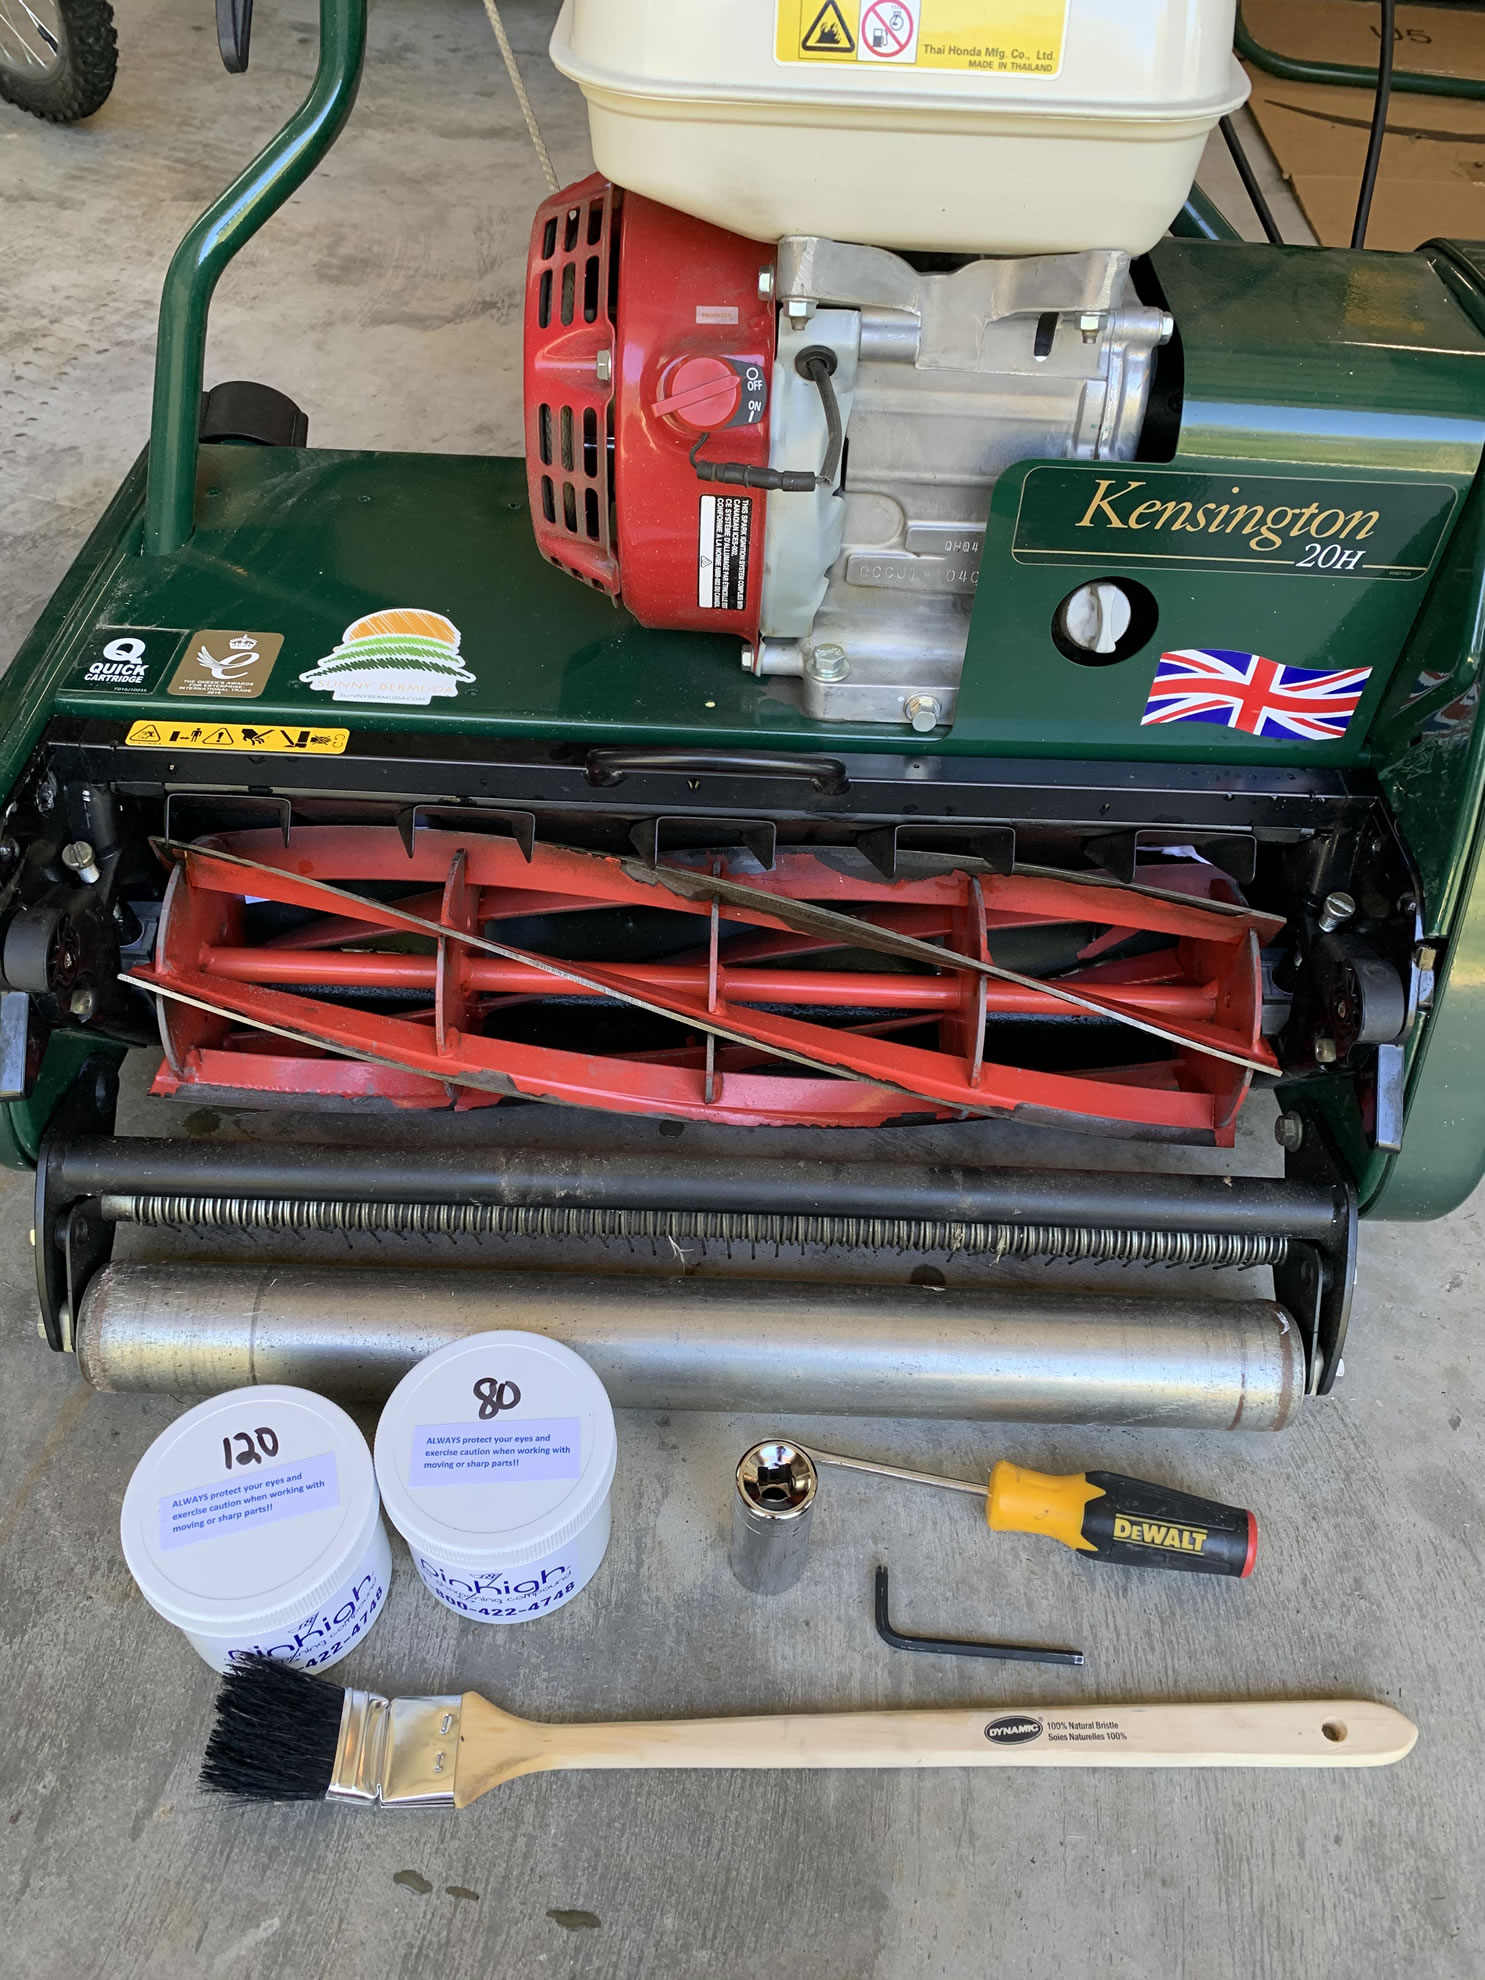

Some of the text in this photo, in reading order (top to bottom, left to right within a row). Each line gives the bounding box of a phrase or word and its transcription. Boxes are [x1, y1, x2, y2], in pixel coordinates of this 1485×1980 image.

[923, 44, 1055, 60] Thai Honda Mfg. Co., Ltd.
[968, 60, 1052, 72] MADE IN THAILAND
[747, 380, 762, 391] OFF
[748, 400, 761, 412] ON
[725, 498, 732, 507] CE
[741, 499, 749, 514] THIS
[716, 498, 724, 533] CONFORME
[732, 499, 741, 531] CANADIAN
[1075, 478, 1380, 552] Kensington
[740, 515, 748, 536] SPARK
[1295, 544, 1366, 571] 20H
[102, 637, 146, 664] Q
[88, 662, 149, 676] QUICK
[84, 673, 144, 684] CARTRIDGE
[317, 680, 454, 694] SUNNY BERMUDA
[473, 1377, 522, 1420] 80
[222, 1426, 279, 1470] 120
[426, 1434, 550, 1446] ALWAYS protect your eyes and
[425, 1445, 571, 1457] exercise caution when working with
[423, 1460, 454, 1470] moving
[466, 1459, 489, 1469] sharp
[491, 1458, 519, 1469] parts!!
[171, 1473, 303, 1508] ALWAYS protect your eyes and
[172, 1480, 325, 1520] exercise caution when working with
[172, 1503, 273, 1534] moving or sharp parts!!
[989, 1721, 1119, 1737] DYNAMIC 100% Natural Bristle
[1048, 1732, 1127, 1741] Soies Naturelles 100%
